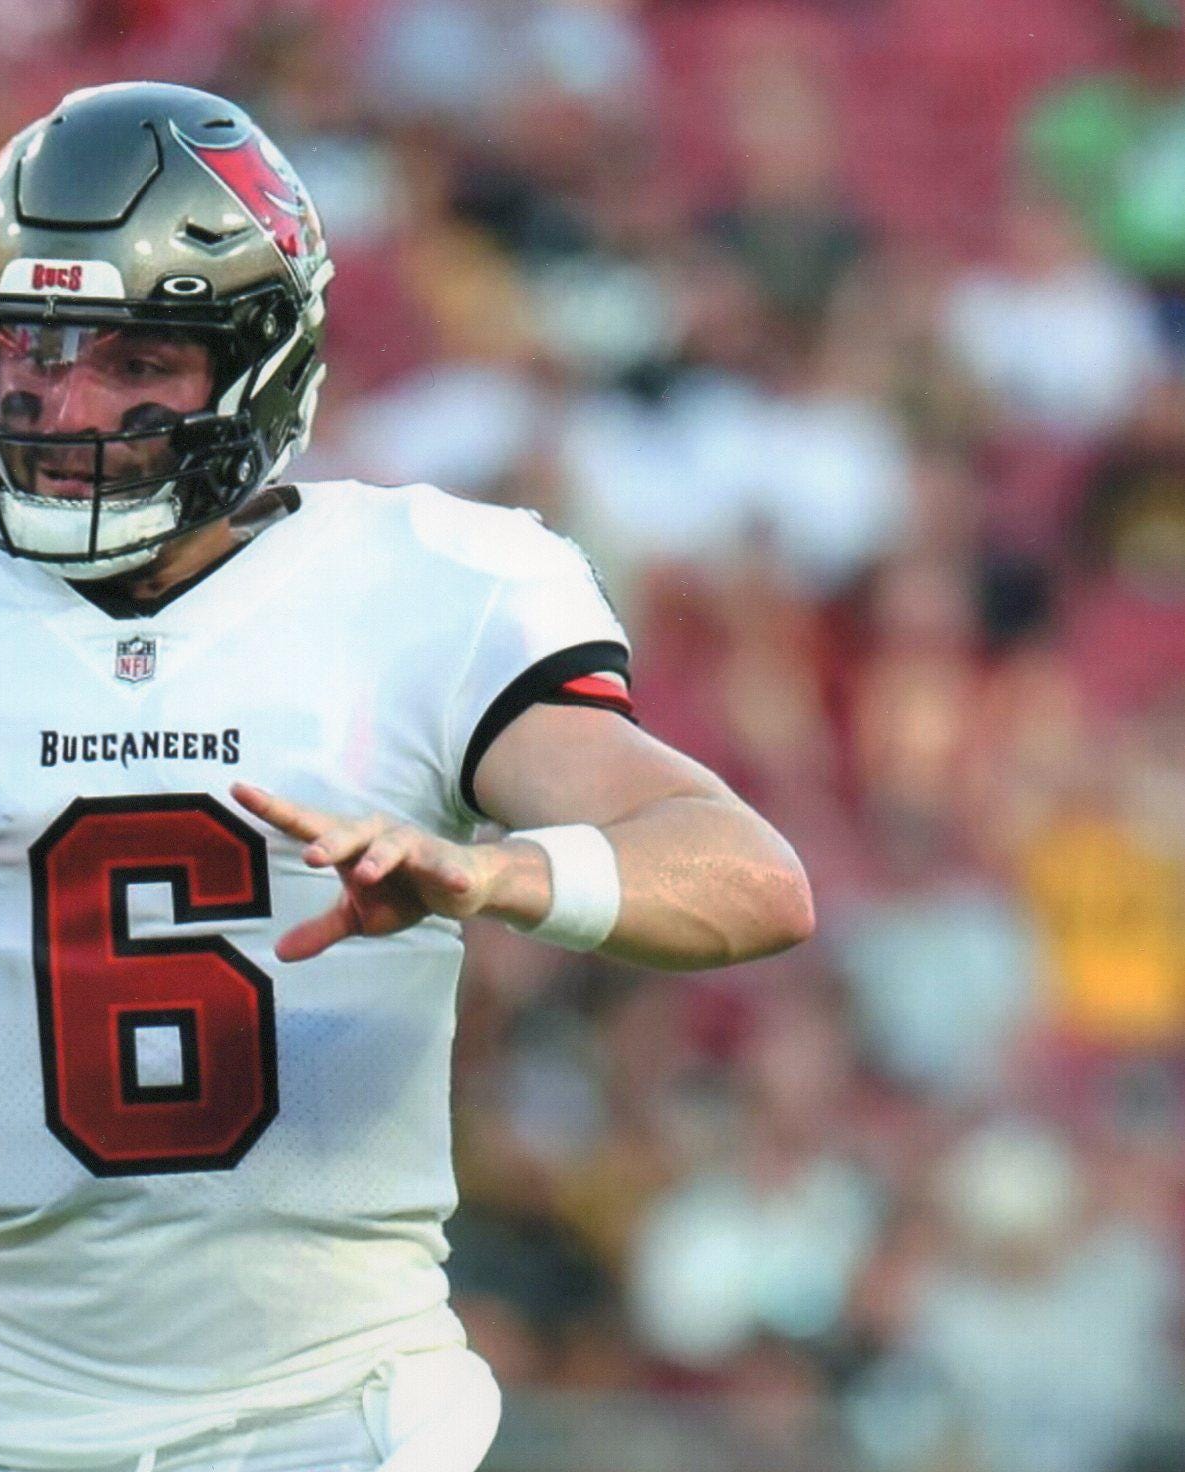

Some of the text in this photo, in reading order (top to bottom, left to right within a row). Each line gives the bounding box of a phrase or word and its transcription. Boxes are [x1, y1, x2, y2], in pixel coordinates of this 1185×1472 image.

[120, 657, 151, 677] NFL
[41, 728, 240, 770] BUCCANEERS
[28, 792, 280, 1178] 6
